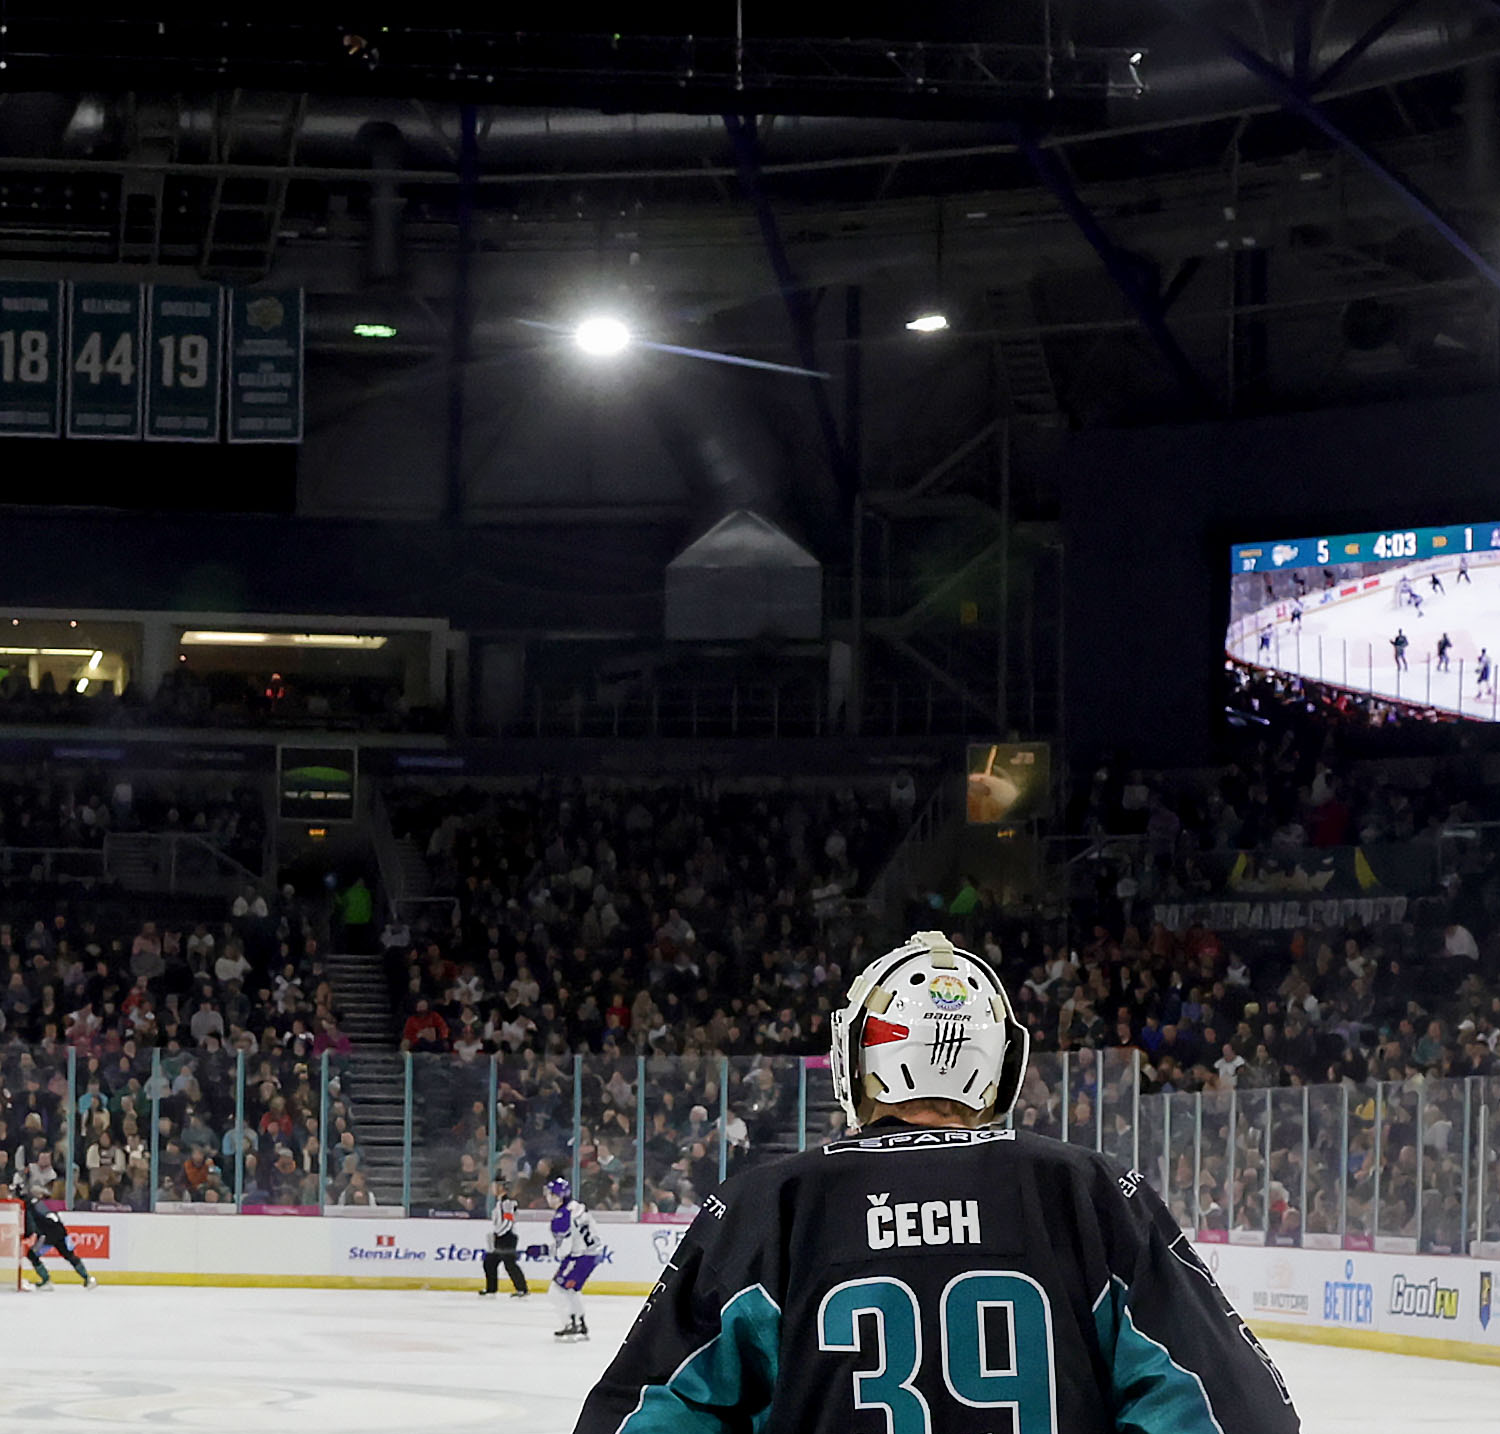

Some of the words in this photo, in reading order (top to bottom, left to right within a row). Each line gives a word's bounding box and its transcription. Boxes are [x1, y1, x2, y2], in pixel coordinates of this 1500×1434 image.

[0, 330, 49, 384] 18
[75, 331, 136, 386] 44
[158, 334, 209, 388] 19
[1317, 540, 1330, 564] 5
[1373, 532, 1417, 559] 4:03
[1464, 527, 1474, 551] 1
[867, 1191, 981, 1250] ČECH
